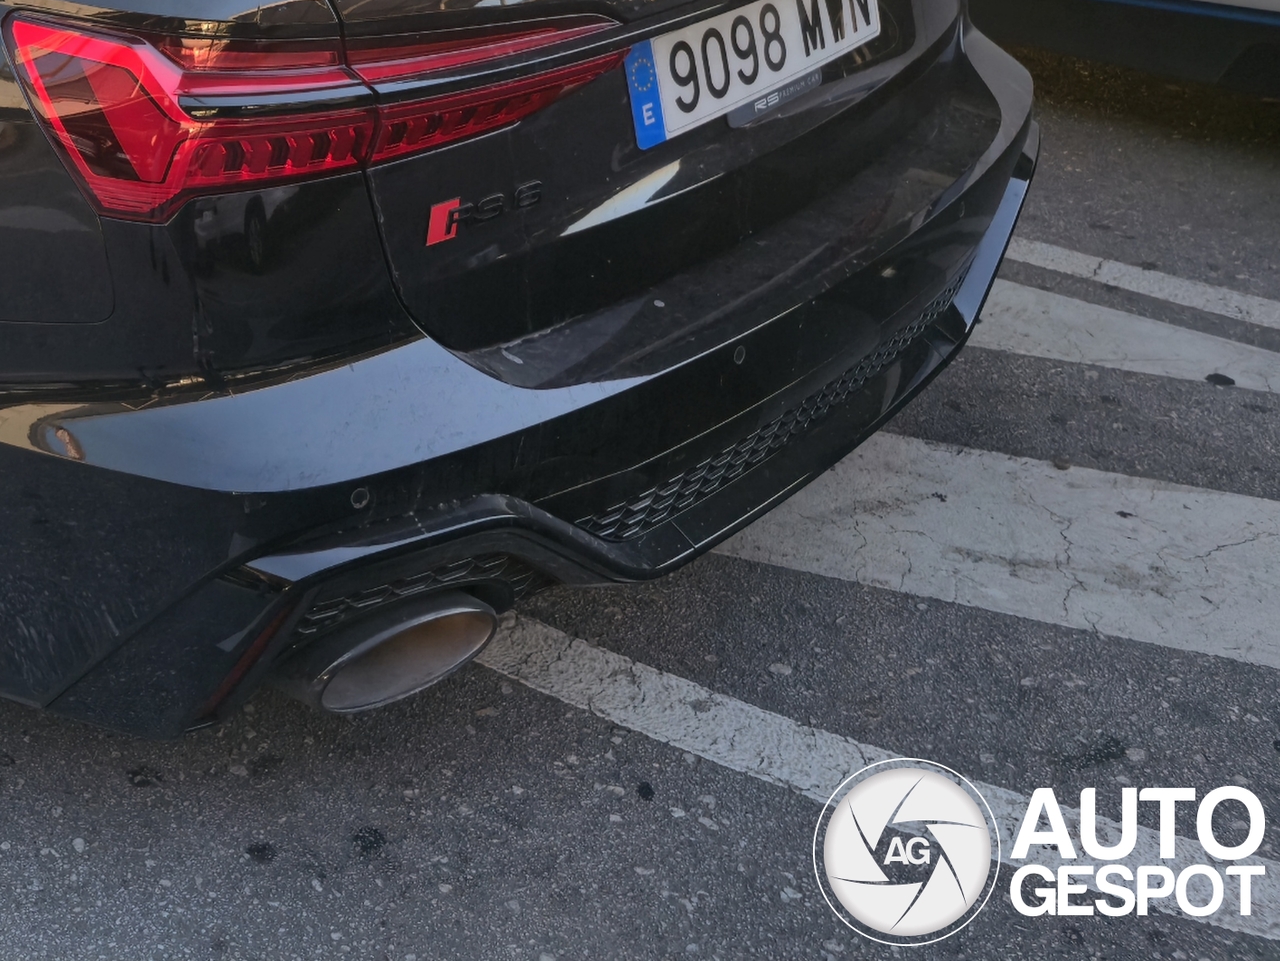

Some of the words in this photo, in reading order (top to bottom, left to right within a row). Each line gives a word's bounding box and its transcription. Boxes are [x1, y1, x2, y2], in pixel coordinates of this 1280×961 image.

[670, 3, 786, 113] 9098
[754, 92, 780, 113] RS
[780, 81, 806, 99] PREMIUM
[807, 73, 819, 86] CAR
[642, 102, 655, 126] E
